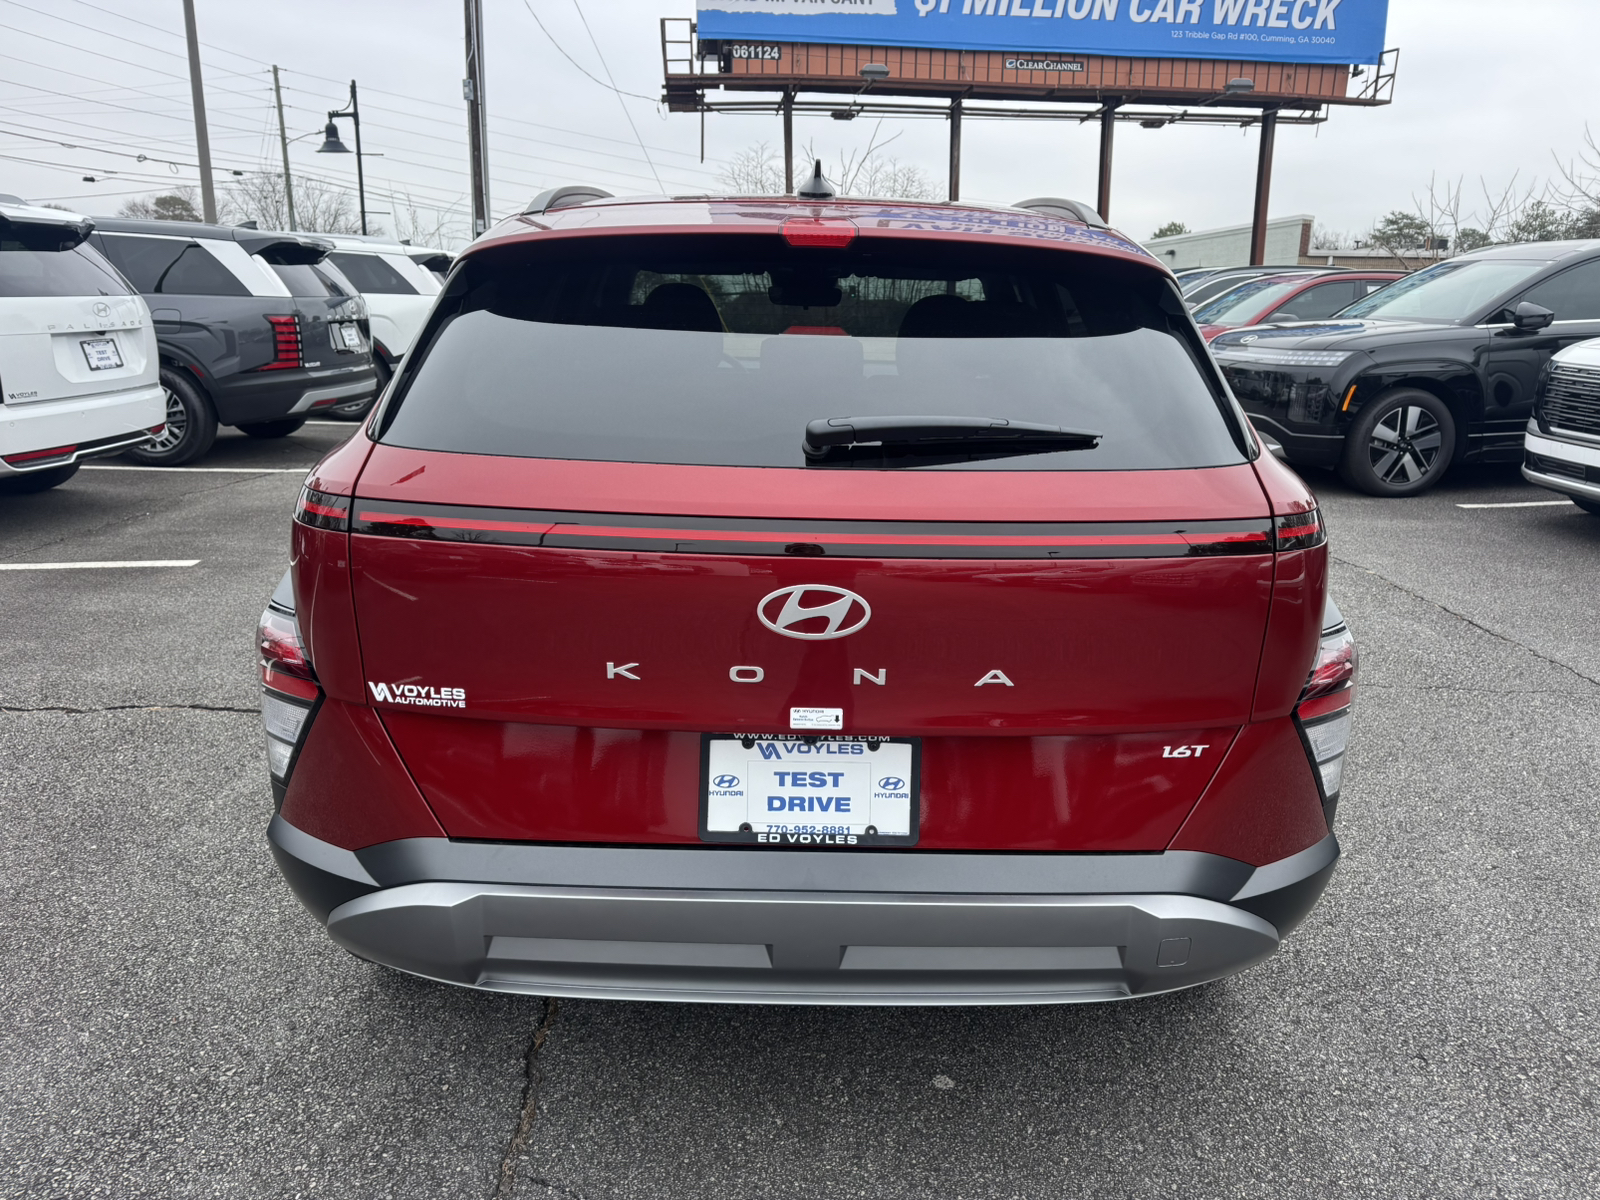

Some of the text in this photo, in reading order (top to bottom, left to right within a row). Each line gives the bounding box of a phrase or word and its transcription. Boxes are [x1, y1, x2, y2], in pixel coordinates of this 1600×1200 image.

[1129, 0, 1202, 24] CAR
[1213, 0, 1341, 30] WRECK
[1171, 30, 1183, 38] 123
[1185, 31, 1210, 39] Tribble
[1211, 32, 1226, 41] Gap
[1239, 33, 1259, 42] #100,
[1261, 34, 1296, 43] Cumming,
[1311, 36, 1336, 44] 30040
[733, 45, 779, 59] 061124
[391, 683, 466, 700] VOYLES
[394, 696, 466, 708] AUTOMOTIVE
[733, 733, 890, 742] WWW.EDLES.COM
[782, 743, 864, 755] VOYLES
[773, 771, 845, 788] TEST
[767, 796, 851, 813] DRIVE
[766, 825, 851, 835] 770-952-8881
[757, 834, 858, 845] ED VOYLES
